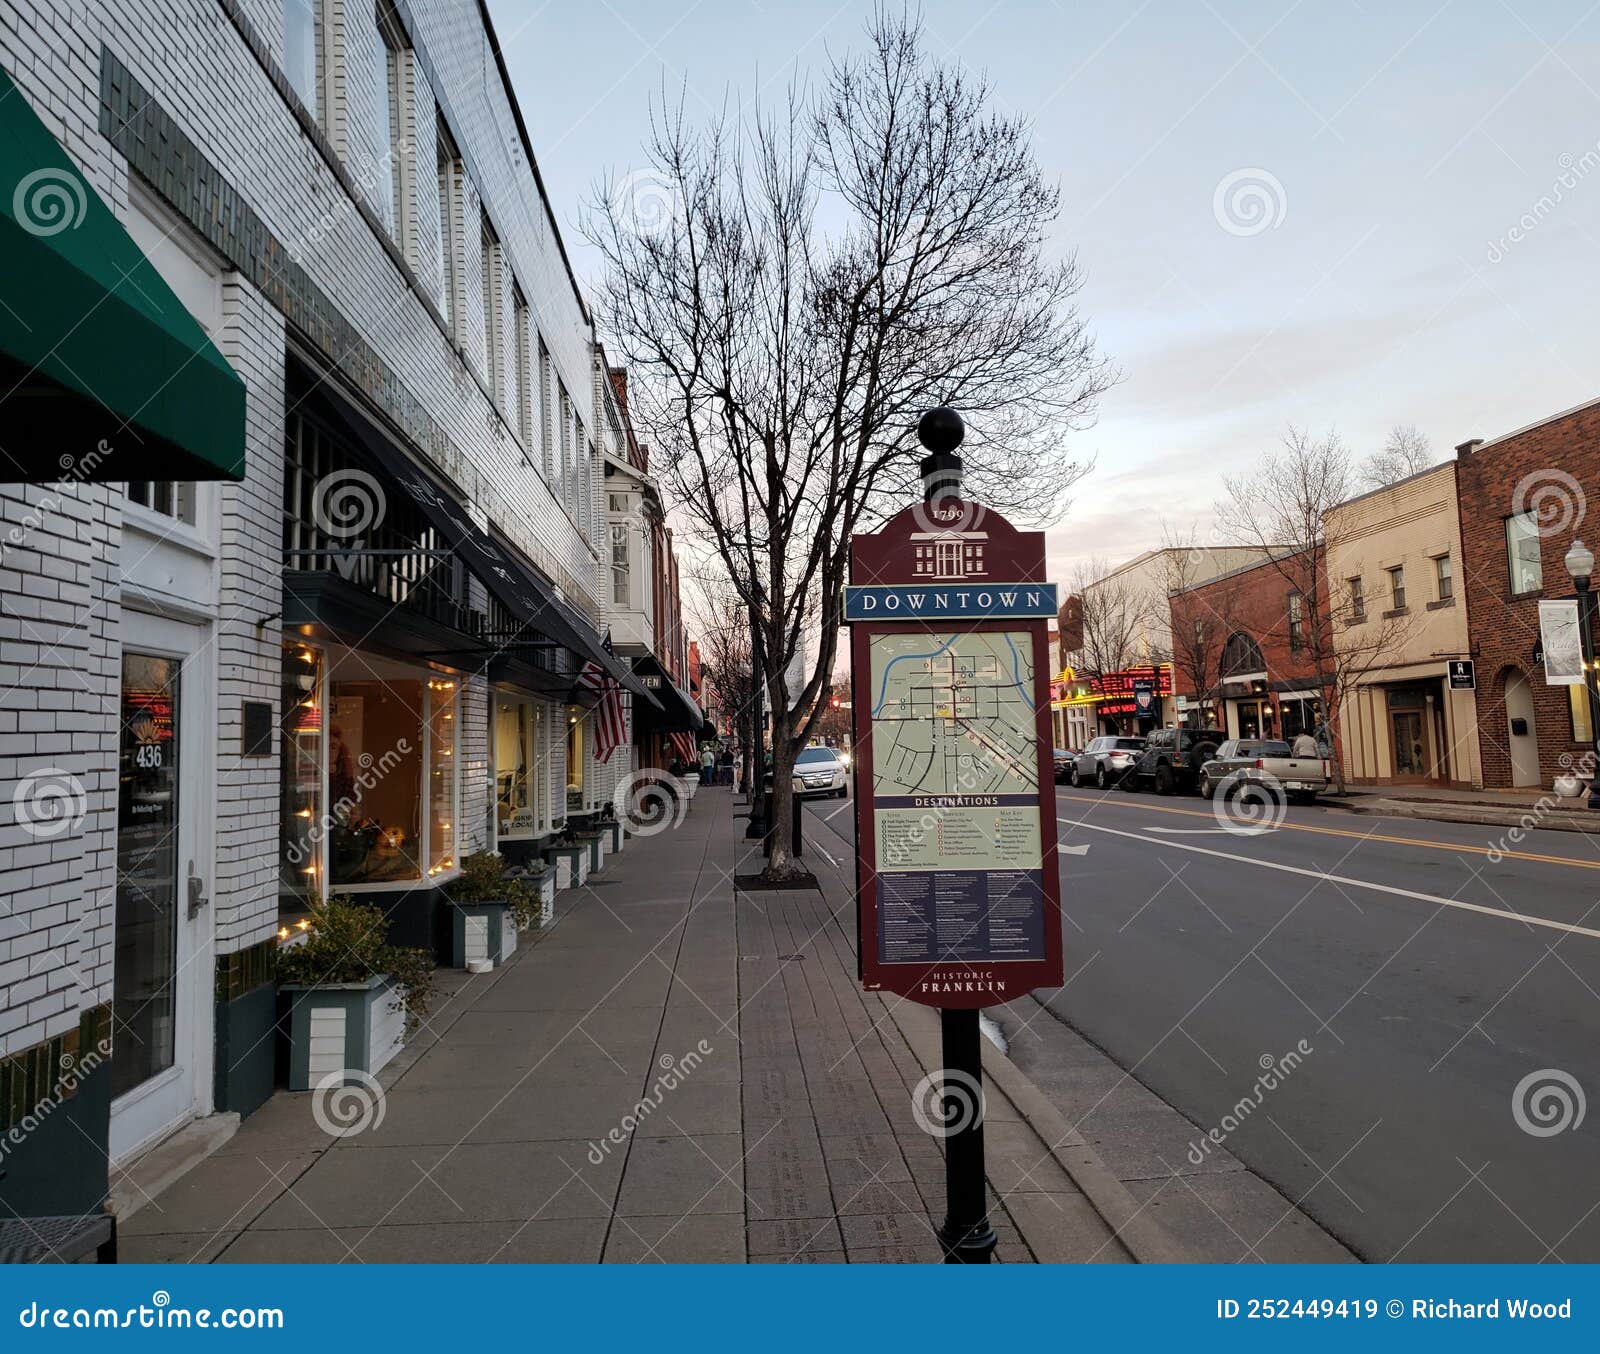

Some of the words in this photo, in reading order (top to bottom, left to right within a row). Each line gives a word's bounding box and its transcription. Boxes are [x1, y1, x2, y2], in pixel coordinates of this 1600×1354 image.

[933, 510, 964, 521] 1799
[863, 592, 1041, 610] DOWNTOWN
[136, 745, 163, 768] 436
[915, 796, 999, 807] DESTINATIONS
[933, 971, 993, 980] HISTORIC
[922, 981, 1006, 993] FRANKLIN
